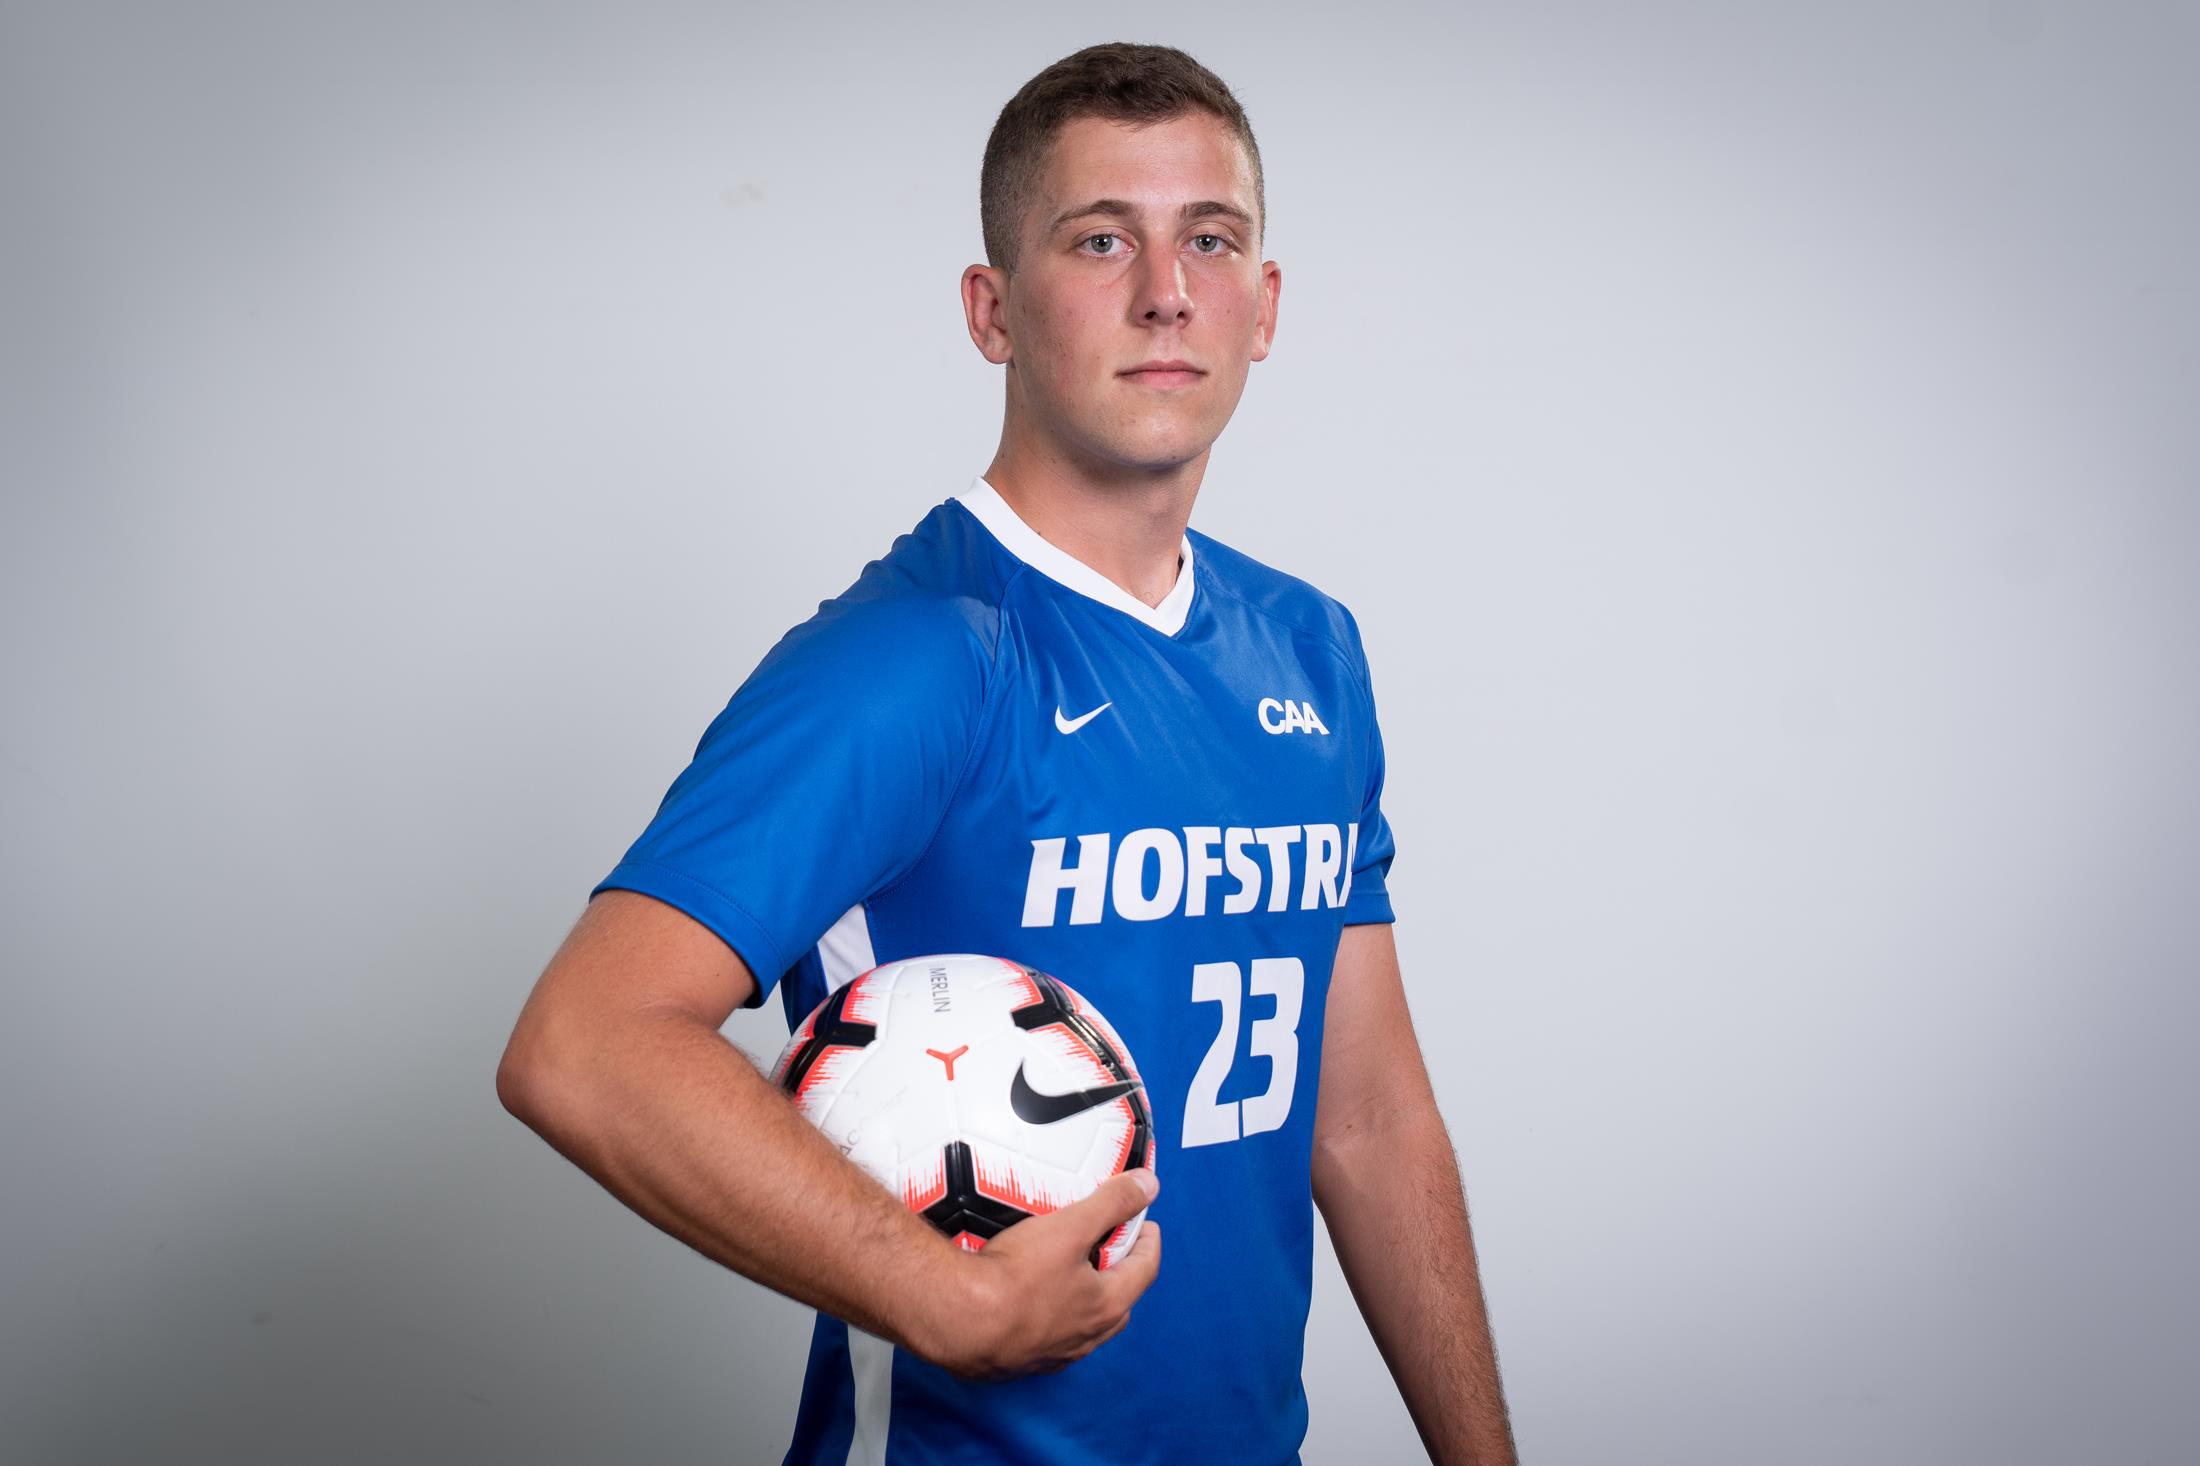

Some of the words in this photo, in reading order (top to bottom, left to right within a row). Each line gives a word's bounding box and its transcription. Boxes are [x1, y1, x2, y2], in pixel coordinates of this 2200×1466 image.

[1258, 697, 1330, 735] CAA
[929, 967, 951, 1013] MERLIN
[1181, 957, 1304, 1148] 23
